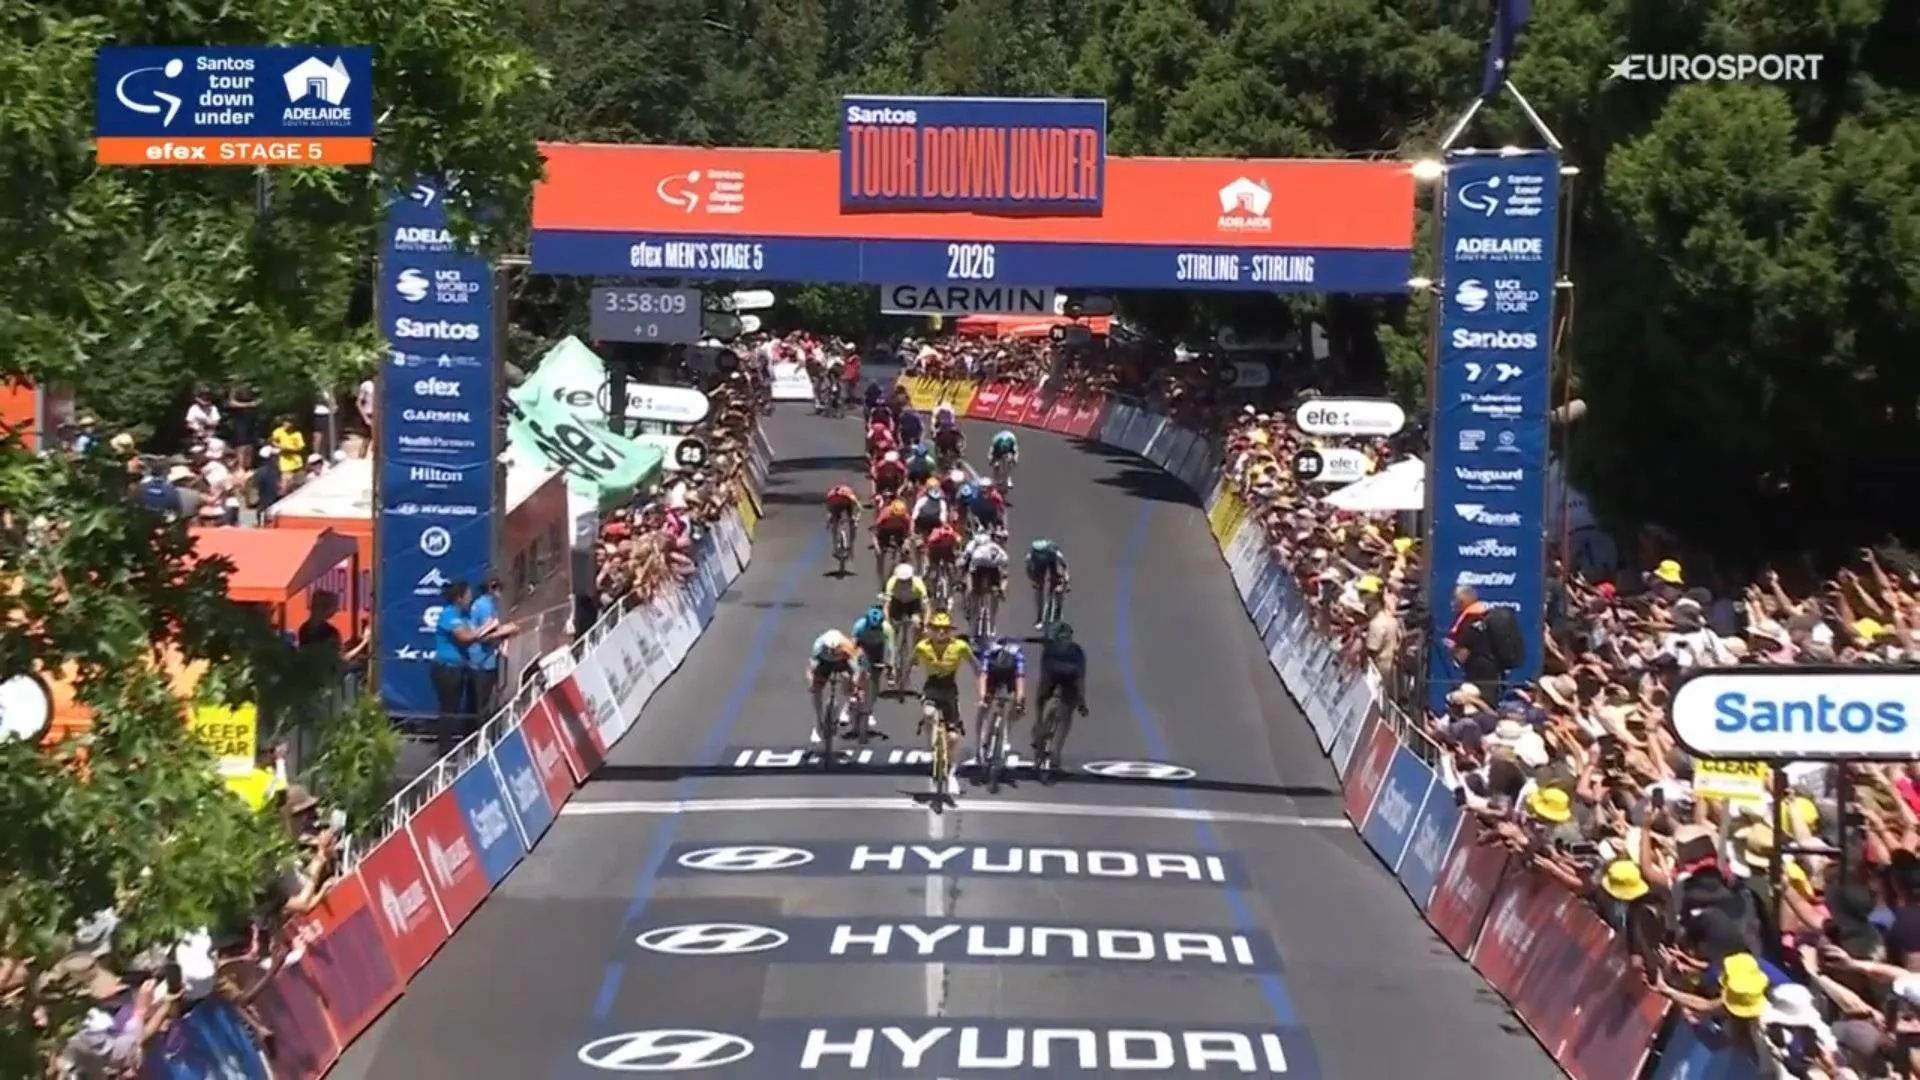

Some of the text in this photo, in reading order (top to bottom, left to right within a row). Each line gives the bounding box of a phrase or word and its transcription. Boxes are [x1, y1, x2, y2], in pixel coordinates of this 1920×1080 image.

[847, 106, 917, 124] Santos
[847, 126, 1099, 200] TOUR DOWN UNDER
[395, 227, 452, 243] ADELA
[1455, 238, 1543, 253] ADELAIDE
[631, 240, 764, 271] efex MEN'S STAGE 5
[947, 243, 995, 279] 2026
[435, 269, 461, 281] UCI
[1176, 253, 1239, 281] STIRLING
[1251, 255, 1315, 283] STIRLING
[435, 281, 480, 293] WORLD
[1494, 279, 1520, 290] UCI
[436, 293, 469, 303] TOUR
[604, 292, 687, 314] 3:58:09
[892, 284, 1045, 312] GARMIN
[1494, 290, 1539, 301] WORLD
[1495, 301, 1528, 312] TOUR
[395, 316, 480, 340] Santos
[647, 324, 659, 337] 0
[1452, 328, 1538, 349] Santos
[414, 376, 461, 397] efex
[403, 408, 471, 423] GARMIN
[410, 466, 463, 481] Hilton
[1298, 457, 1318, 472] 25
[1455, 466, 1523, 484] Vanguard
[1457, 571, 1517, 586] Santini
[1714, 690, 1908, 734] Santos
[196, 723, 249, 740] KEEP
[849, 845, 1226, 882] HYUNDAI
[830, 923, 1256, 965] HYUNDAI
[800, 1026, 1289, 1073] HYUNDAI
